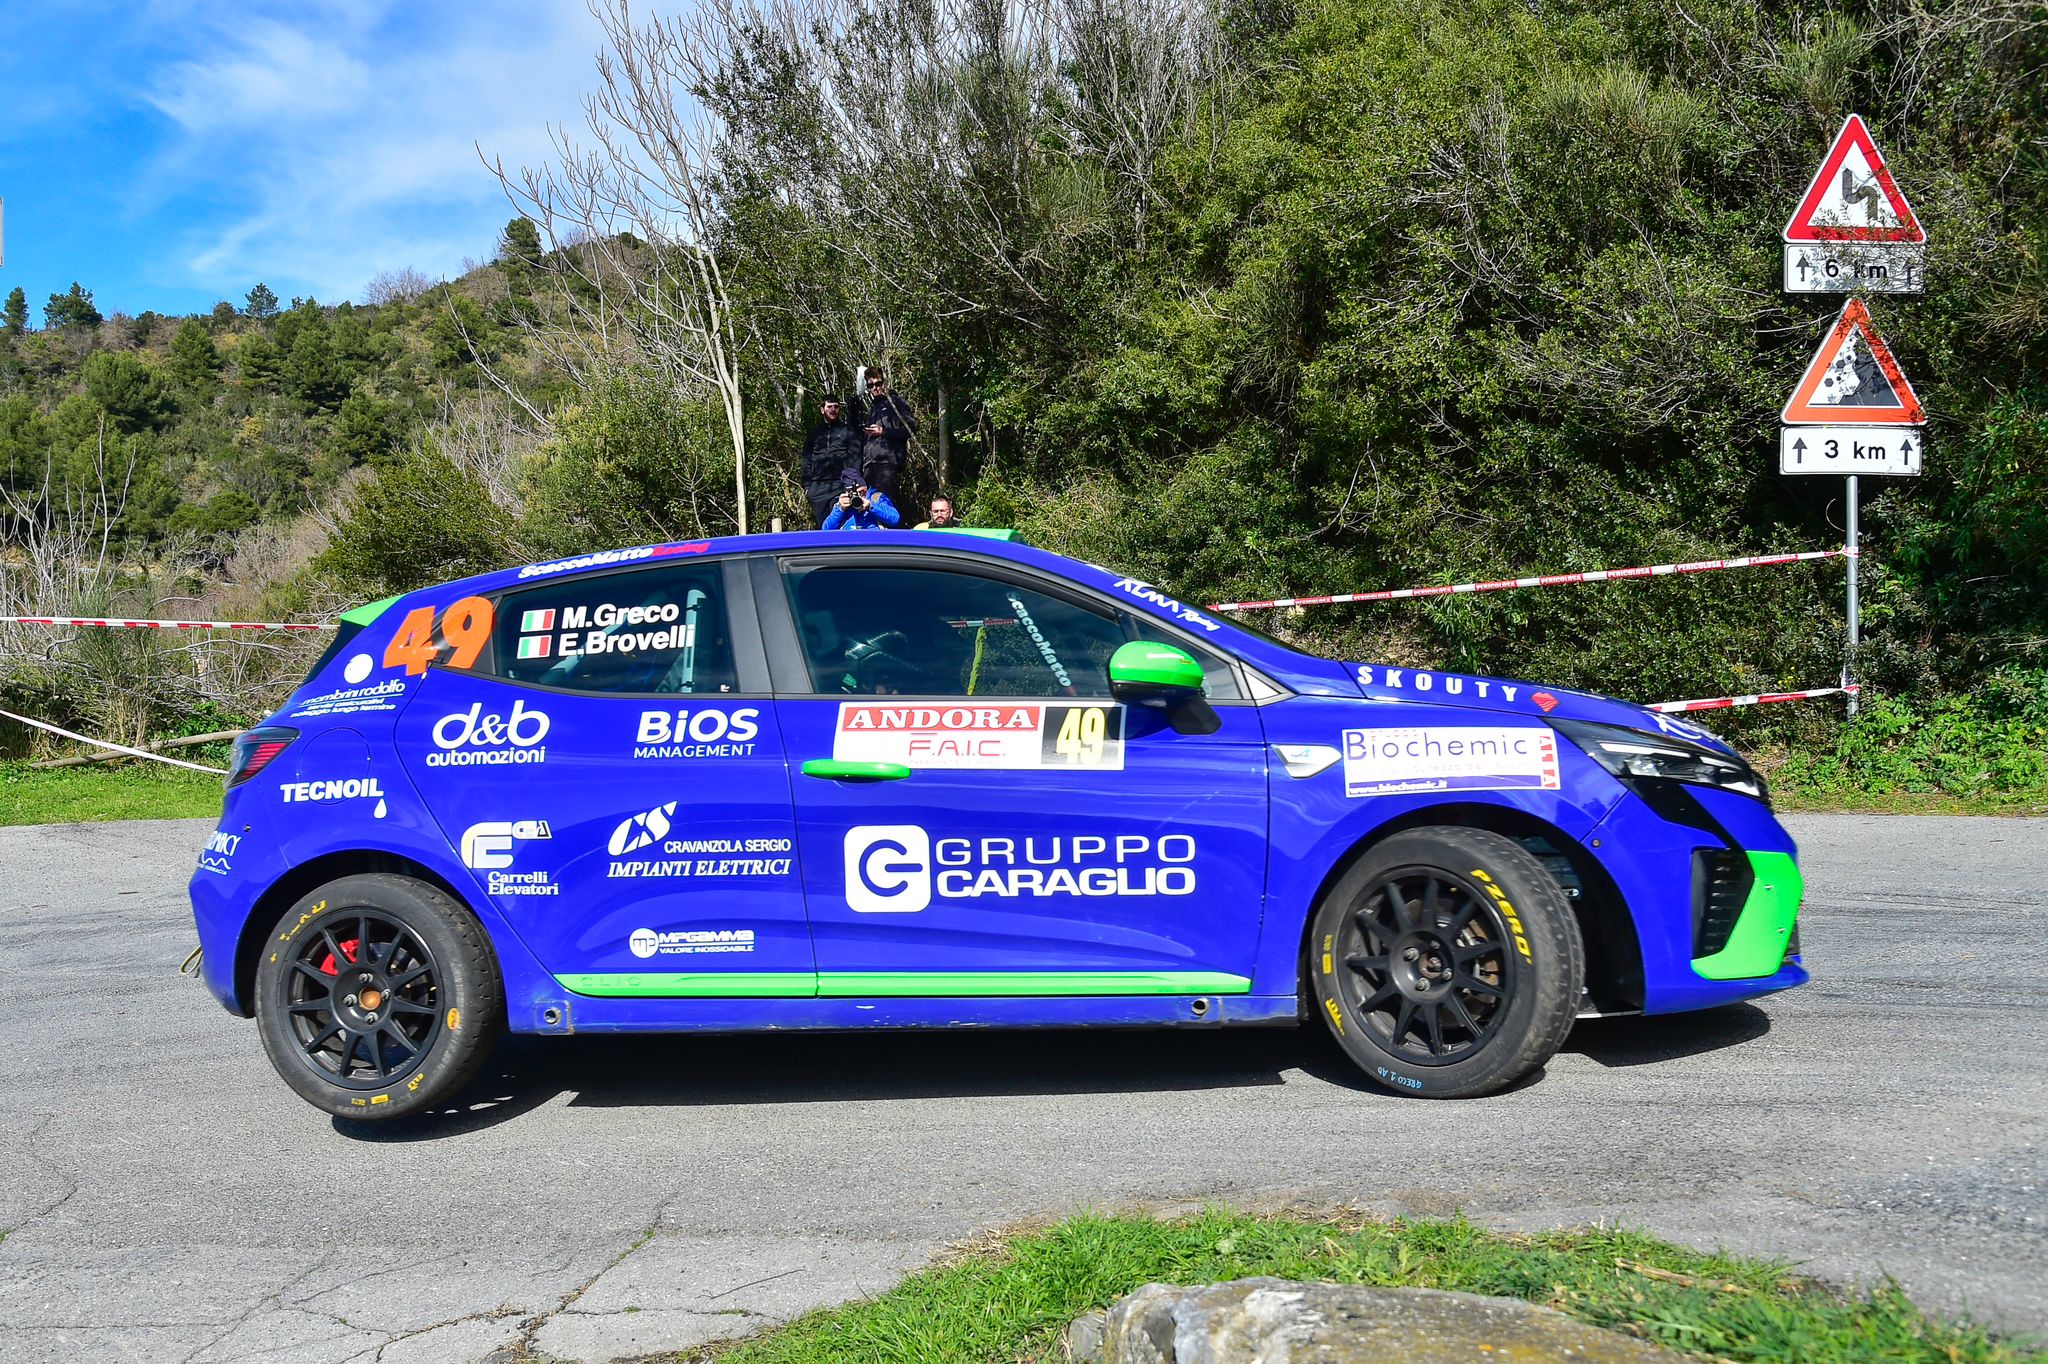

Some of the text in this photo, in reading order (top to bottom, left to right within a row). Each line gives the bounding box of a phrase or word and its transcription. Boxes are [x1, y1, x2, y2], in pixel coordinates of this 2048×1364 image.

[1825, 258, 1840, 278] 6
[1824, 440, 1886, 461] 3 km
[1540, 574, 1583, 584] PERICOLOSA
[1607, 567, 1650, 578] PERICOLOSA
[1677, 561, 1723, 571] PERICOLOSA
[561, 604, 680, 629] M.Greco
[382, 596, 495, 676] 49
[558, 624, 696, 656] E.Brovelli
[1356, 665, 1518, 702] SKOUTY
[432, 699, 551, 750] d&b
[846, 708, 1035, 729] ANDORA
[1056, 708, 1107, 763] 49
[1346, 731, 1528, 760] Biochemic
[426, 746, 546, 767] automazioni
[633, 743, 756, 759] MANAGEMENT
[280, 778, 385, 803] TECNOIL
[664, 838, 792, 854] CRAVANZOLA SERGIO
[935, 834, 1196, 866] GRUPPO
[487, 871, 548, 884] Carrelli
[607, 858, 792, 878] IMPIANTI ELETTRICI
[487, 882, 560, 896] Elevatori
[936, 867, 1196, 898] CARAGLIO
